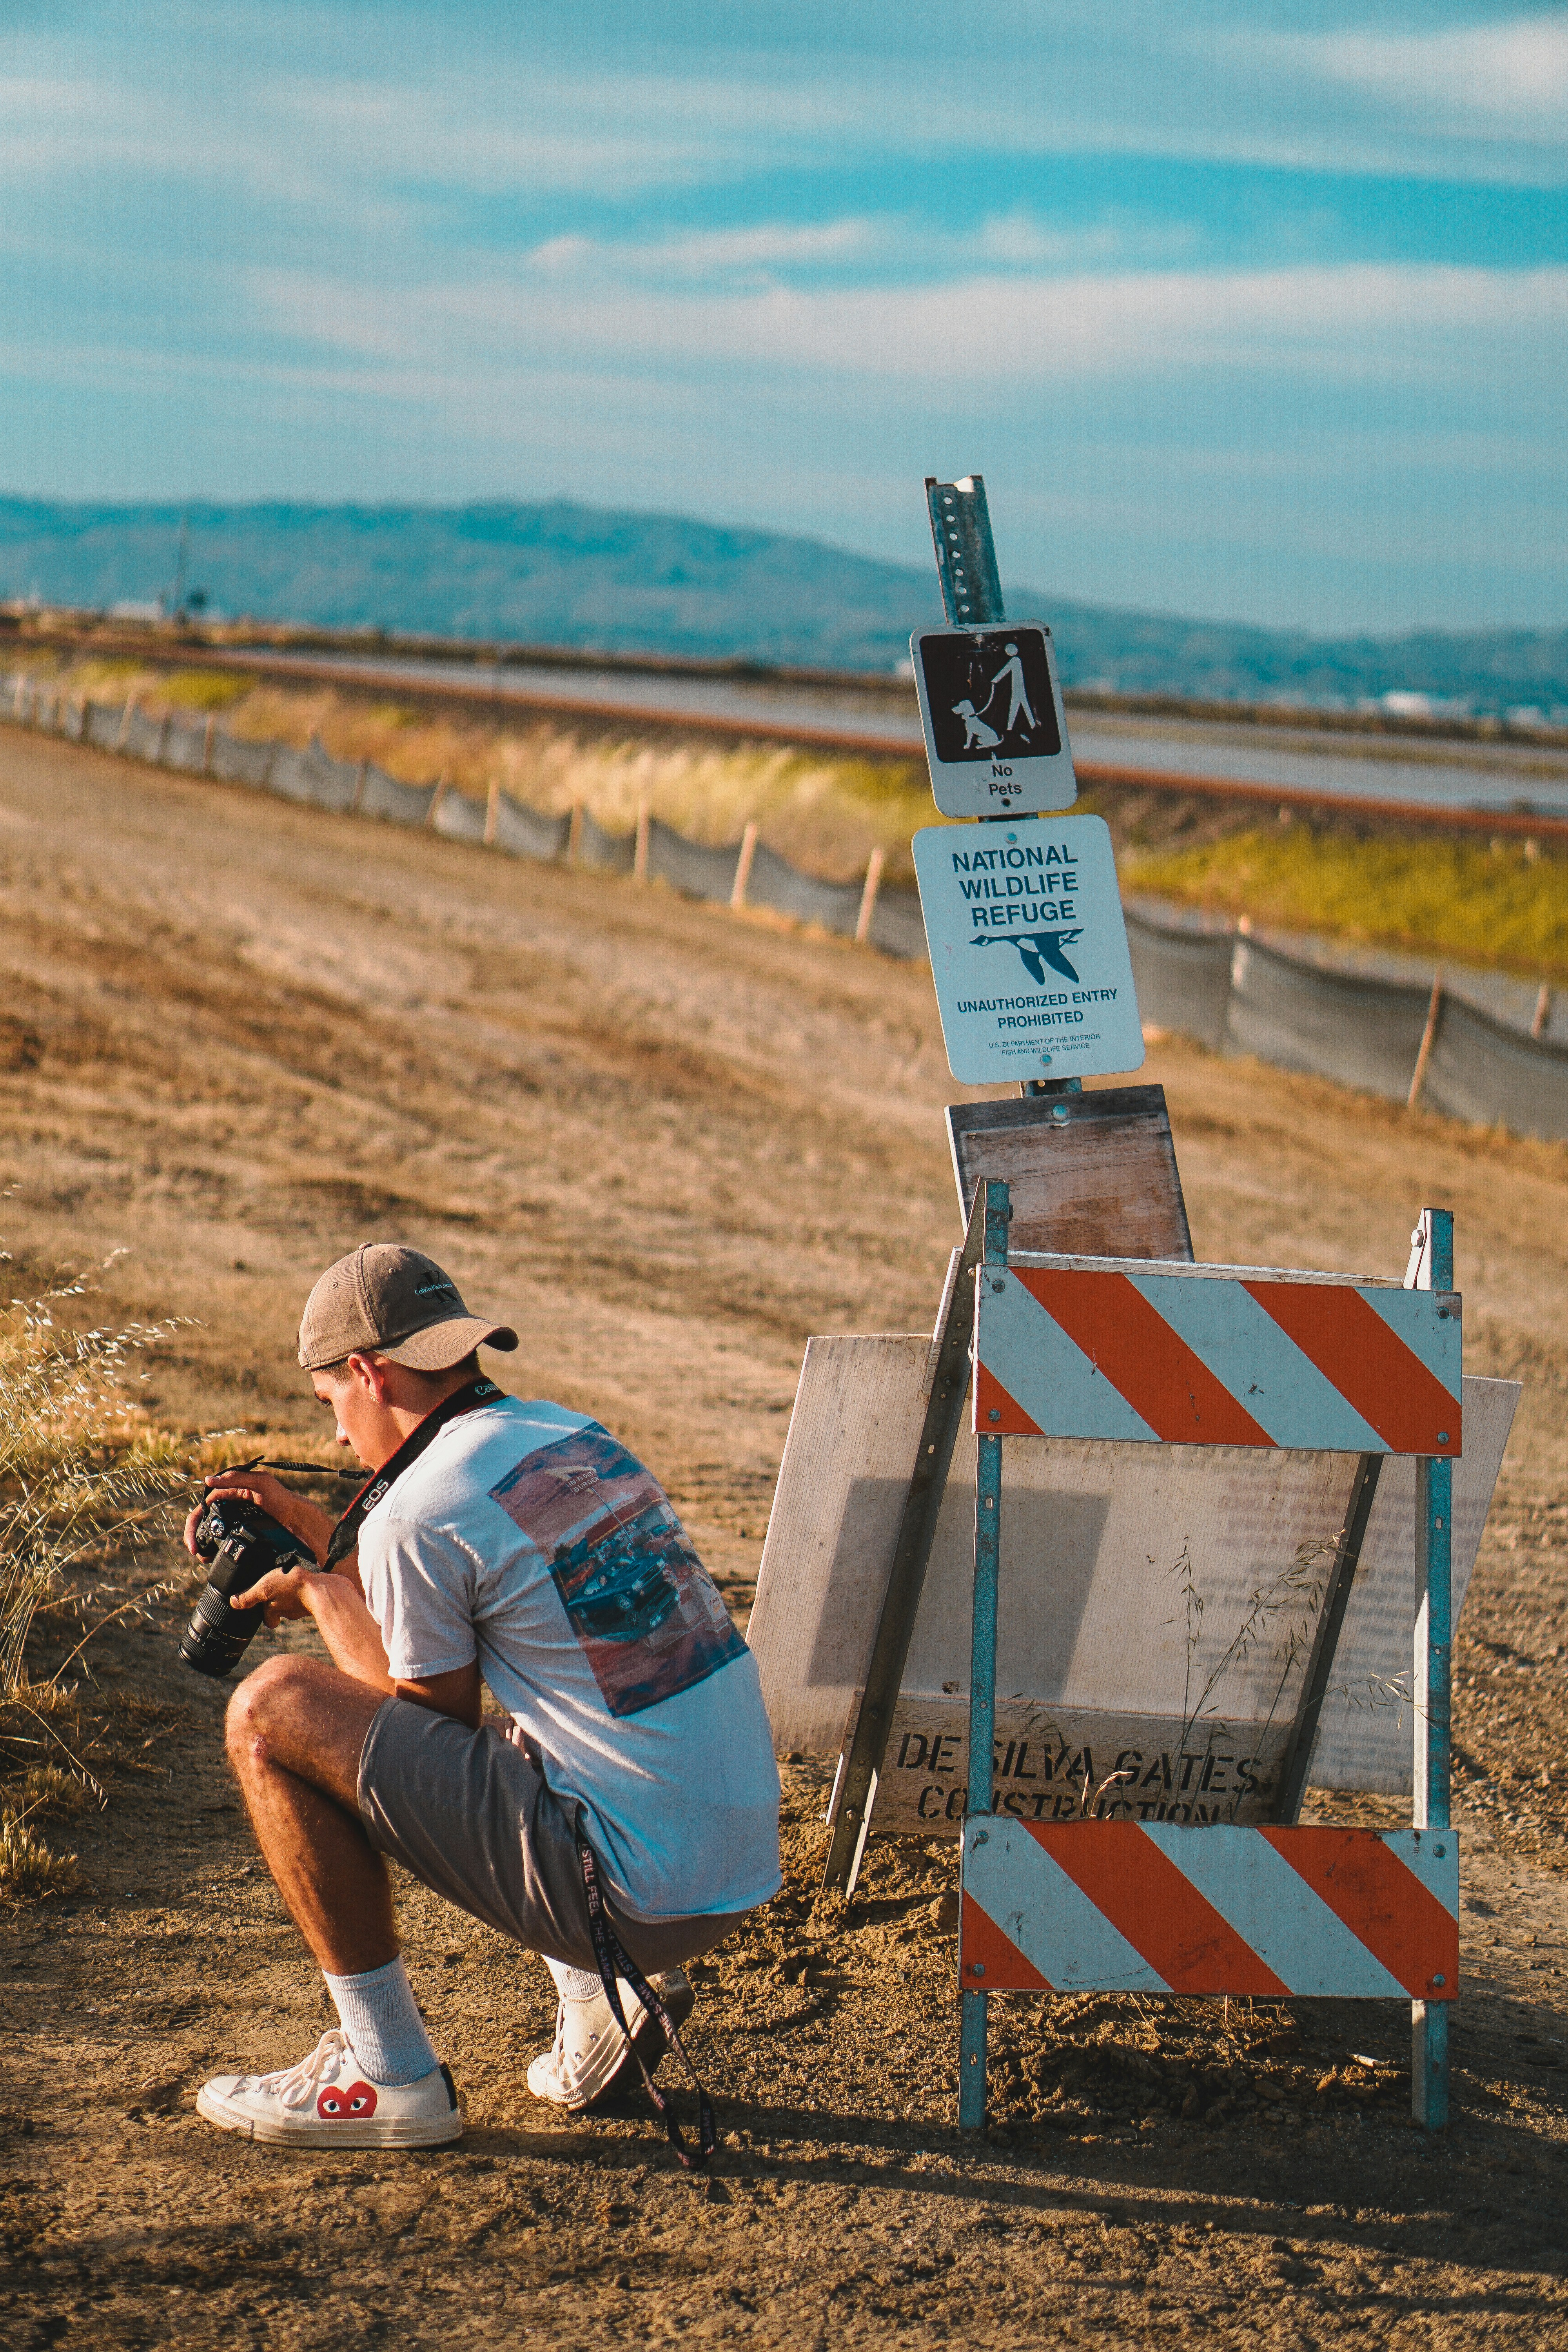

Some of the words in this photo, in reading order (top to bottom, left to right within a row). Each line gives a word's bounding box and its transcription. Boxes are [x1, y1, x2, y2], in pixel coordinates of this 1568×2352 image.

[992, 764, 1013, 777] No
[989, 782, 1022, 796] Pets
[952, 844, 1078, 873] NATIONAL
[958, 871, 1079, 900] WILDLIFE
[971, 900, 1076, 927] REFUGE
[957, 993, 1068, 1013] UNAUTHORIZED
[1072, 988, 1118, 1004] ENTRY
[998, 1011, 1084, 1029] PROHIBITED
[1002, 1039, 1043, 1048] DEPARTMENT
[1069, 1033, 1100, 1042] INTERIOR
[1031, 1045, 1061, 1054] WILDLIFE
[1062, 1042, 1090, 1051] SERVICE
[362, 1479, 389, 1510] EOS
[573, 1476, 600, 1492] BURGER
[897, 1732, 961, 1772] DE
[1114, 1750, 1261, 1794] GATES
[582, 1849, 595, 1884] STILL
[593, 1918, 604, 1944] THE
[598, 1947, 612, 1980] SAME
[612, 1942, 633, 1972] STILL
[636, 1982, 663, 2014] SAME
